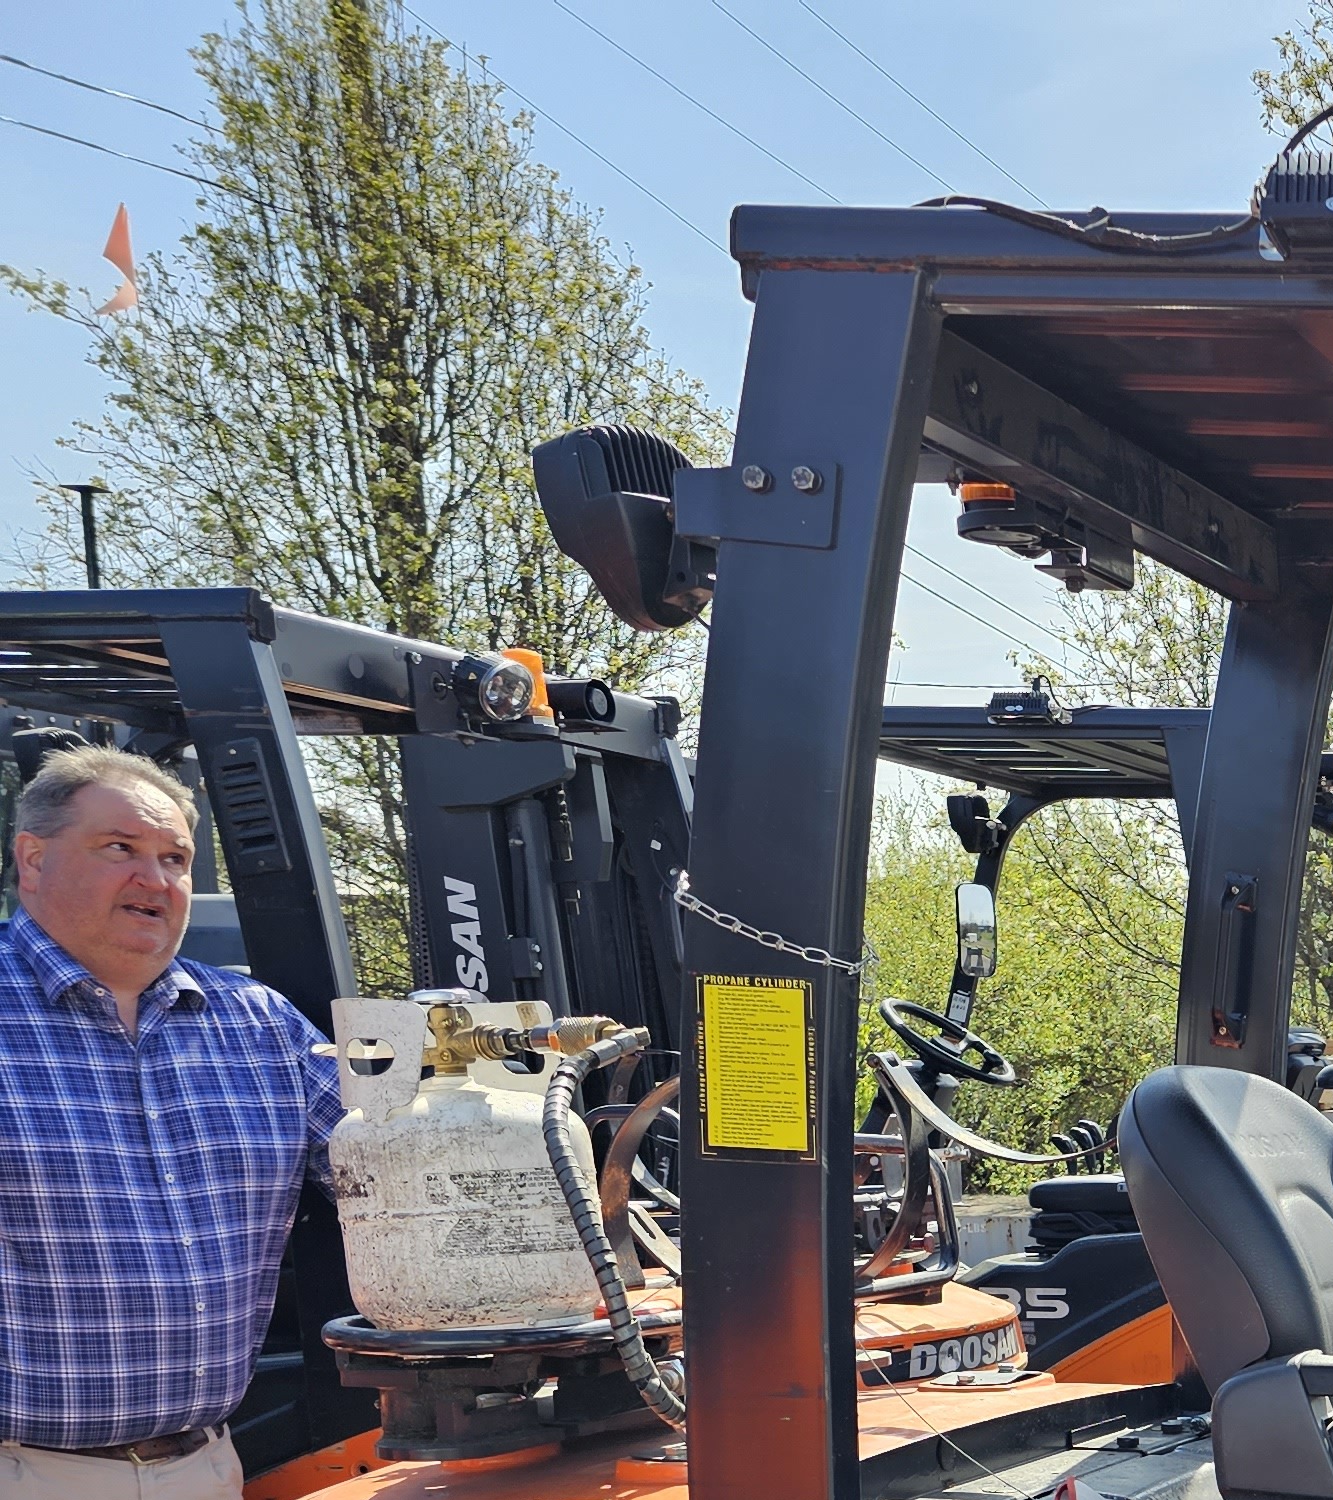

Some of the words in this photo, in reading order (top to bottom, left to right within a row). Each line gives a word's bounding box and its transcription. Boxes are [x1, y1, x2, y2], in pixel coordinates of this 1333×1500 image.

[703, 974, 751, 987] PROPANE
[754, 977, 806, 990] CYLINDER
[909, 1322, 1018, 1378] DOOSAN
